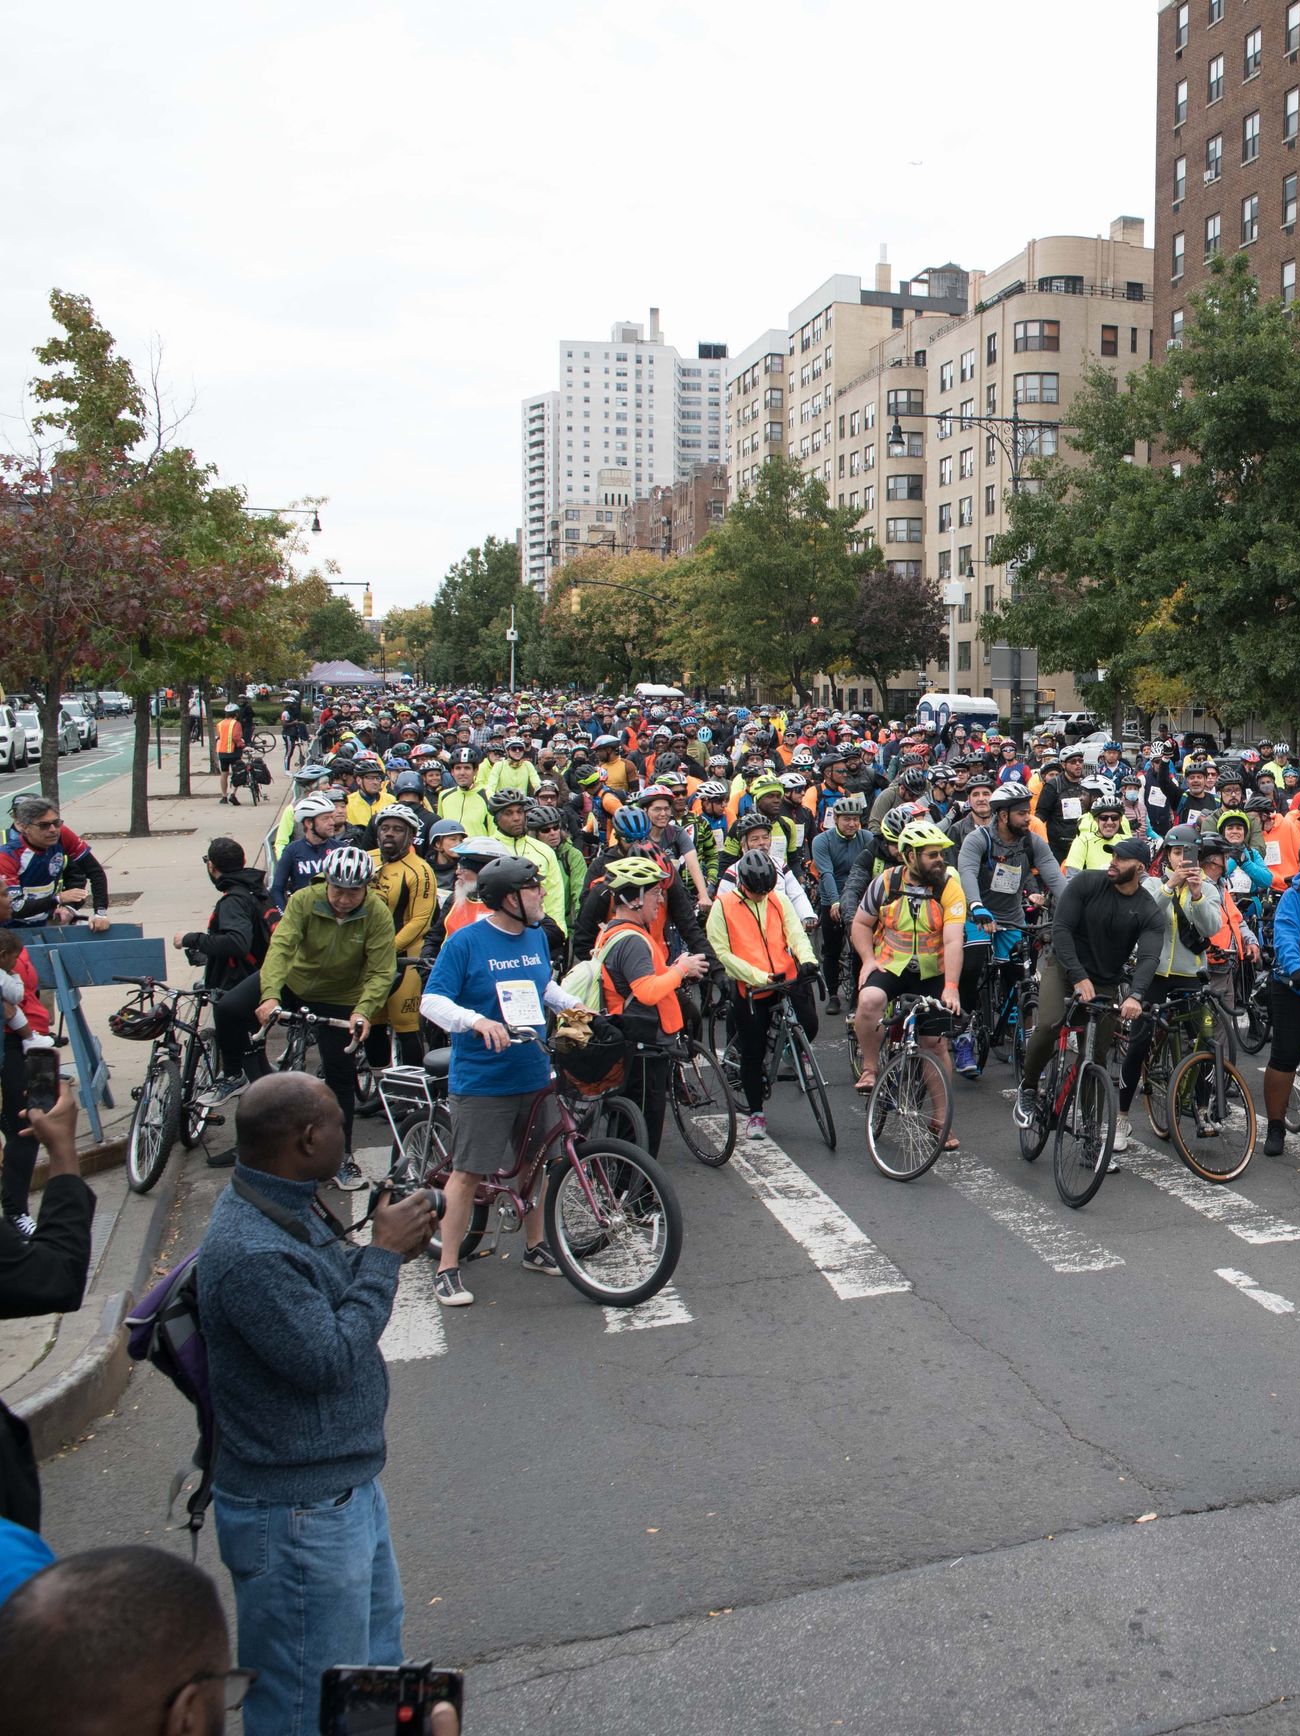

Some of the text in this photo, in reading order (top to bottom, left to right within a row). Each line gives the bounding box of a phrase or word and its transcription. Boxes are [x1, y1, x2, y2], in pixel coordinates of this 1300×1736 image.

[298, 858, 324, 875] NY
[488, 953, 542, 972] Ponce Bank
